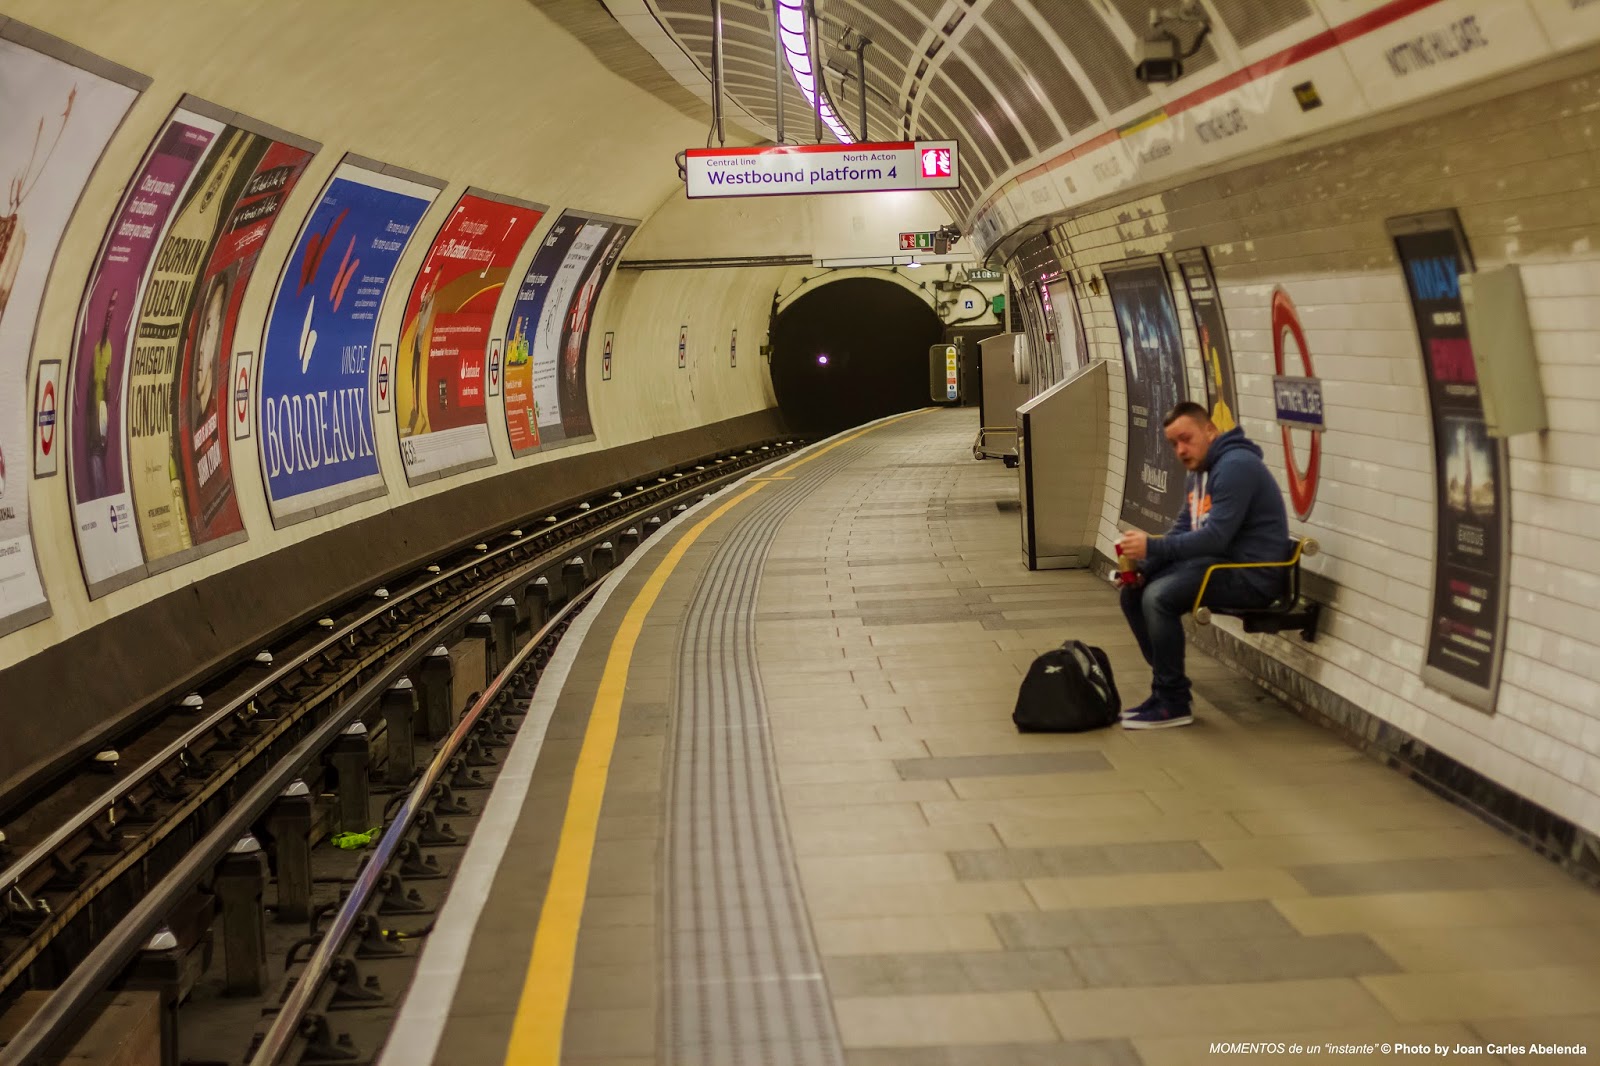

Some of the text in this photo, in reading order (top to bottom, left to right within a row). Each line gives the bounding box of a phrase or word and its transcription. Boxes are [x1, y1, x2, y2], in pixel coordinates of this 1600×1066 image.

[1454, 15, 1489, 53] GATE
[706, 157, 757, 167] Central line
[707, 165, 898, 186] Westbound platform 4
[843, 152, 897, 162] North Acton
[158, 236, 196, 274] BORN
[184, 238, 207, 276] IN
[1410, 256, 1458, 300] IMAX
[144, 279, 192, 318] DUBLIN
[133, 345, 176, 377] RAISED IN
[341, 345, 368, 375] VINS DE
[131, 382, 170, 438] LONDON
[266, 387, 374, 478] BORDEAUX
